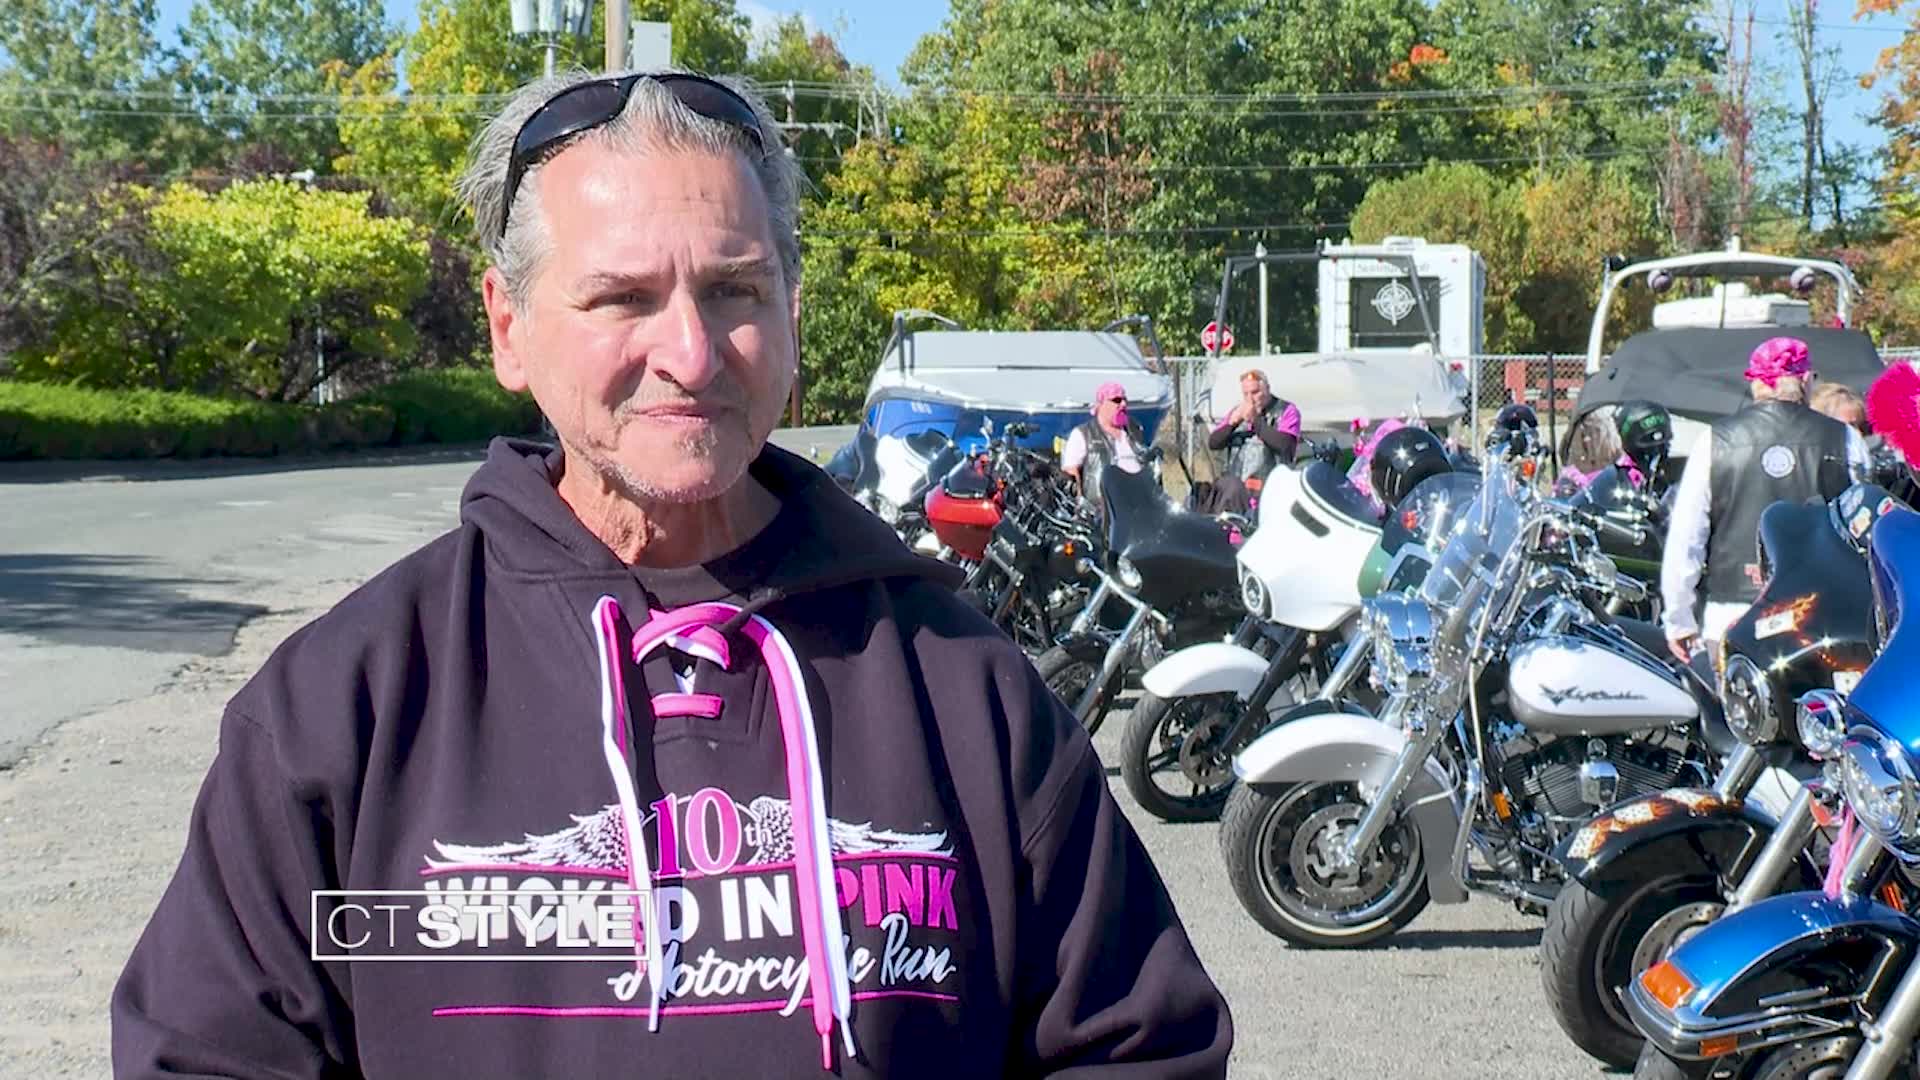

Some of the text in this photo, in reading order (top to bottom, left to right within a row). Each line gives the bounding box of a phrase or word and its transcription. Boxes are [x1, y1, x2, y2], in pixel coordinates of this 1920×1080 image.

[1204, 330, 1228, 343] STP
[720, 874, 793, 942] IN
[607, 912, 956, 1017] Motorcye Run
